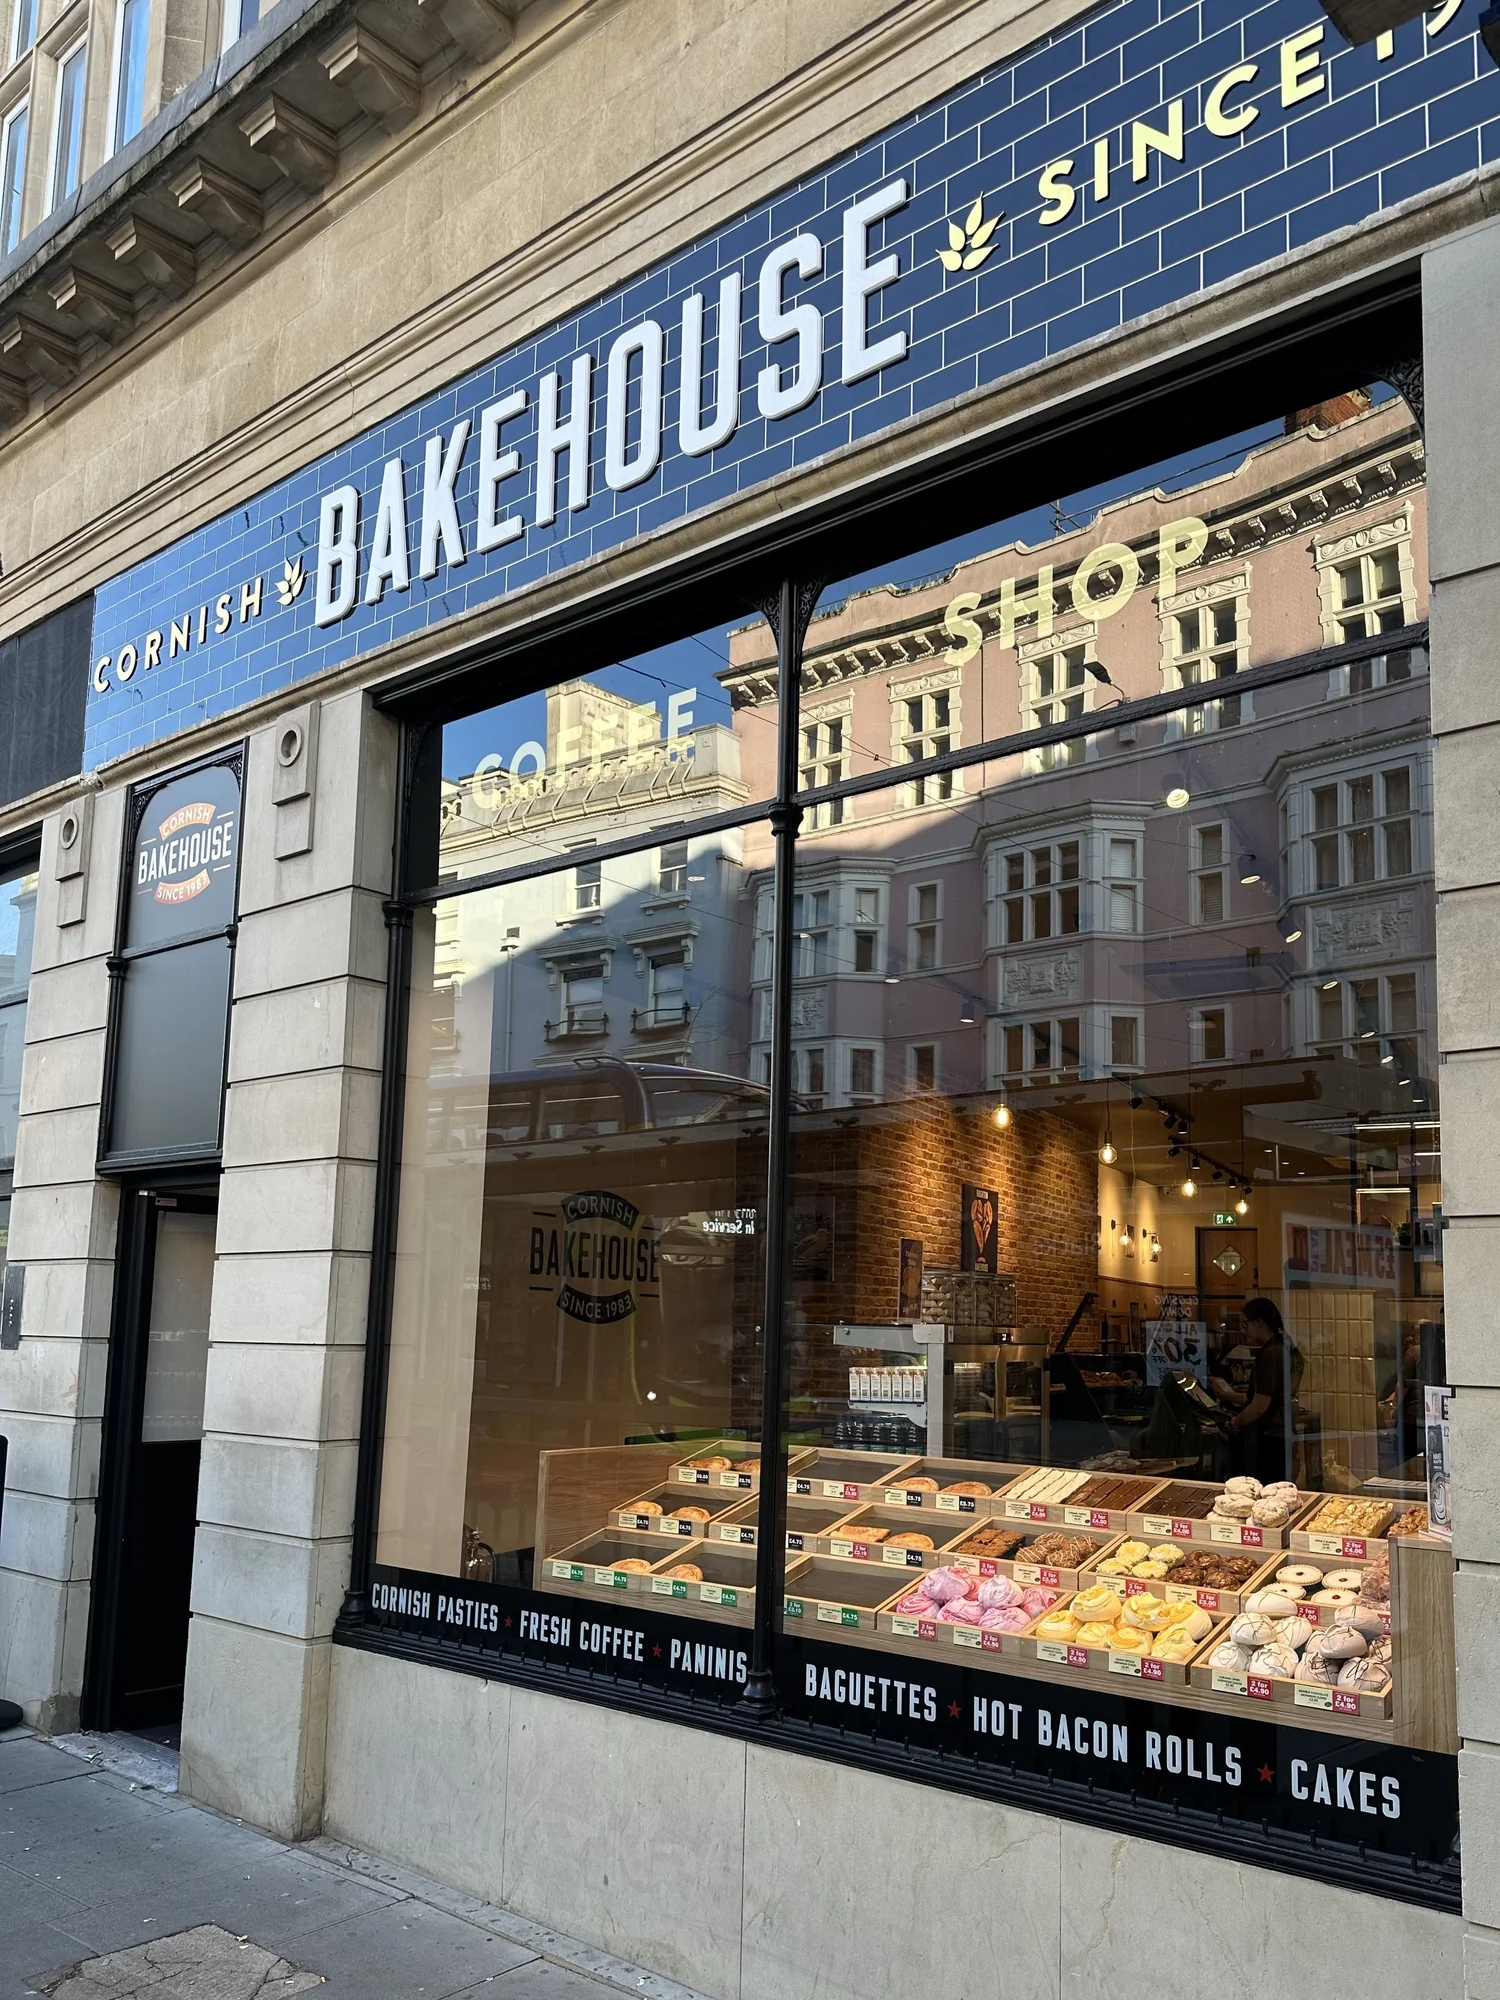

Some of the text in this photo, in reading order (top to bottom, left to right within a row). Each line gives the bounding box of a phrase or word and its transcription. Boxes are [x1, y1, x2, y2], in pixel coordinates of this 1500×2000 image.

[94, 25, 1325, 692] CORNISH BAKEHOUSE SINCE
[943, 516, 1209, 666] SHOP
[472, 688, 697, 809] COFFEE
[162, 807, 211, 836] CORNISH
[138, 821, 234, 885] BAKEHOUSE
[158, 874, 208, 901] SINCE 1983
[567, 1196, 634, 1225] CORNISH
[529, 1226, 661, 1283] BAKEHOUSE
[562, 1291, 633, 1319] SINCE 1983
[1345, 1546, 1363, 1554] £4.00
[372, 1582, 499, 1632] CORNISH PASTIES
[519, 1610, 644, 1662] FRESH COFFEE
[1069, 1655, 1086, 1663] £4.90
[670, 1639, 748, 1684] PANINIS
[1143, 1667, 1162, 1676] £4.90
[805, 1664, 937, 1722] BAGUETTES
[1250, 1686, 1269, 1695] £4.90
[1335, 1701, 1356, 1710] £4.90
[973, 1696, 1242, 1786] HOT BACON ROLLS
[1290, 1758, 1401, 1819] CAKES
